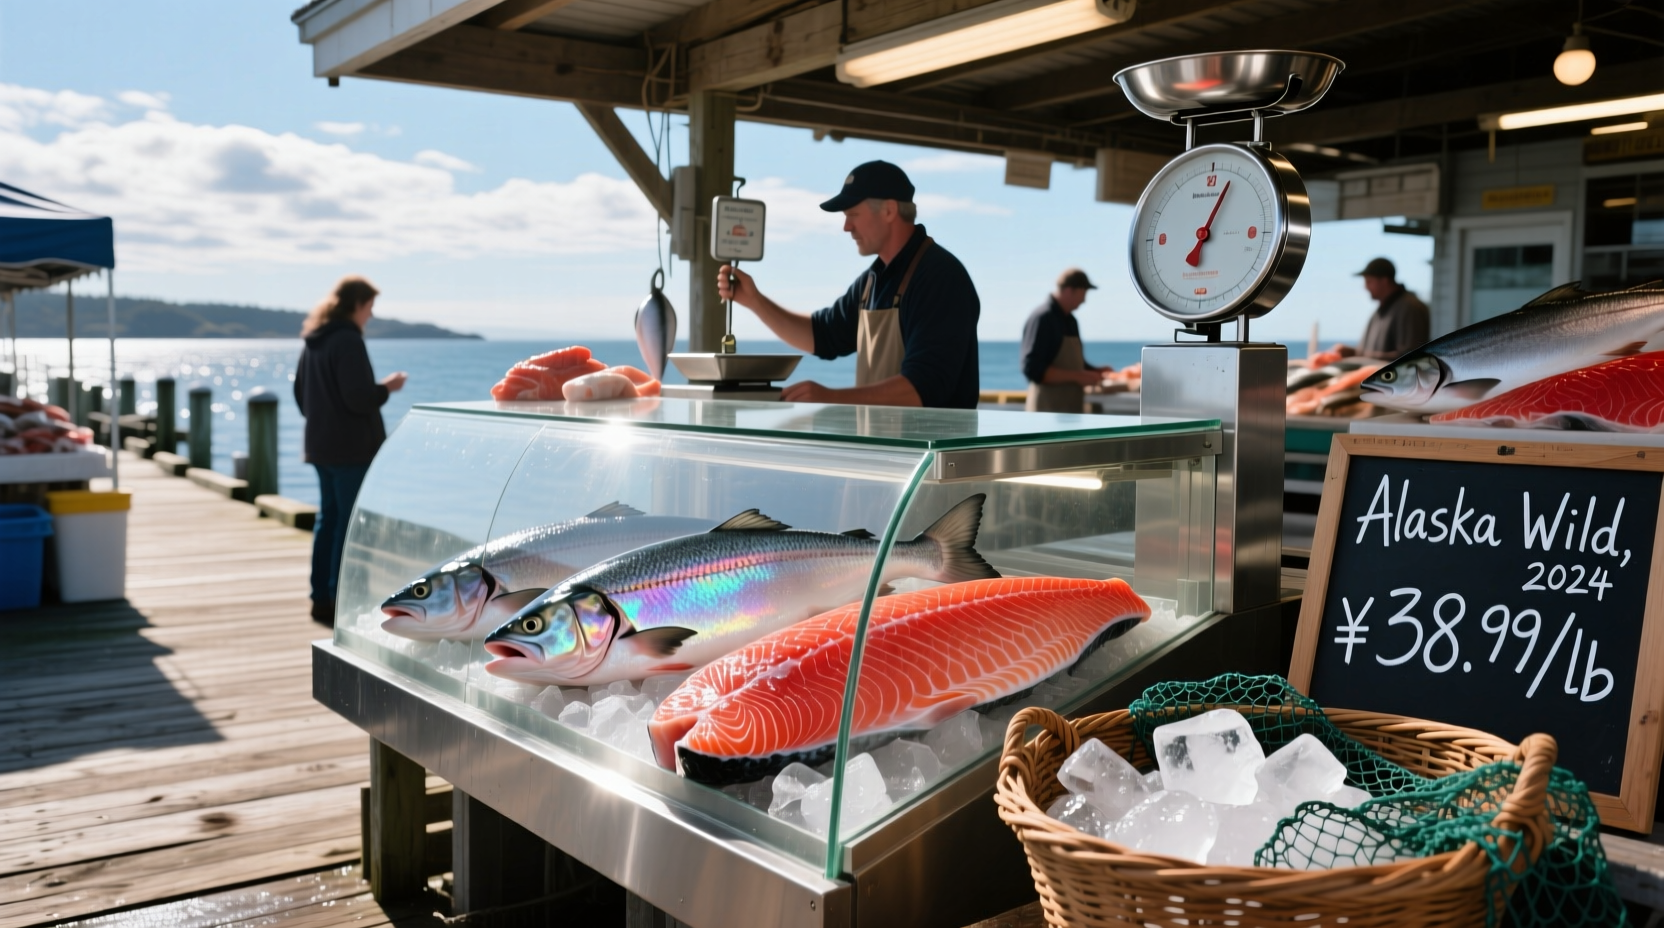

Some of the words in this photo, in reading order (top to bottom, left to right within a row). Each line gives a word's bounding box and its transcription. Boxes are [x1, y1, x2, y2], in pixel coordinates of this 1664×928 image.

[1355, 474, 1502, 547] Alaska
[1523, 491, 1632, 567] Wild,
[1521, 561, 1614, 601] 2024
